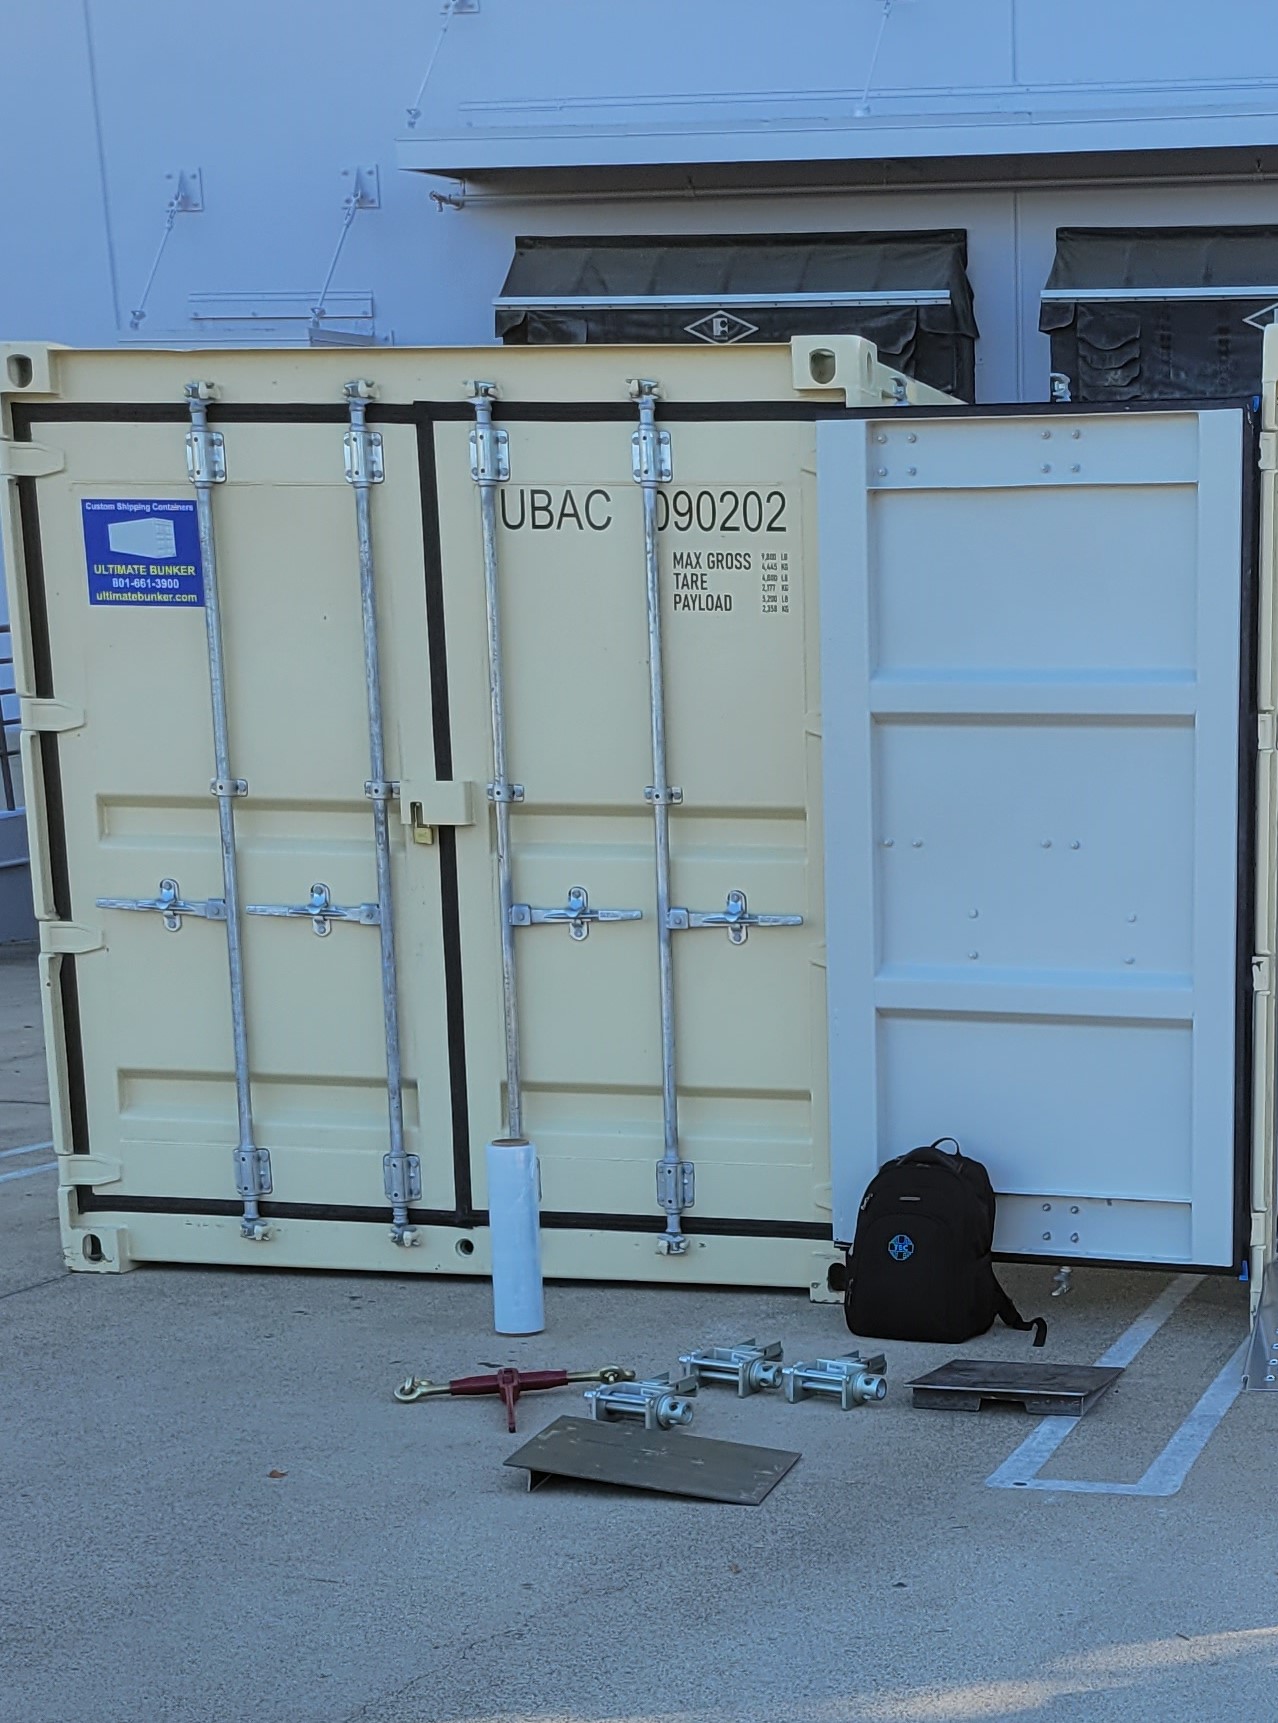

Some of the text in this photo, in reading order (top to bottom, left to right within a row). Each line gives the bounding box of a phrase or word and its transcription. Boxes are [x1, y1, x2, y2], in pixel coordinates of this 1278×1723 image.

[85, 502, 194, 513] Custom Shipping Containers
[500, 488, 613, 531] UBAC
[673, 551, 752, 571] MAX GROSS
[781, 563, 788, 571] KG
[94, 564, 196, 576] ULTIMATE BUNKER
[112, 578, 180, 589] 801-661-3900
[673, 572, 708, 591] TARE
[96, 591, 198, 603] ultimatebunker.com
[673, 594, 733, 612] PAYLOAD
